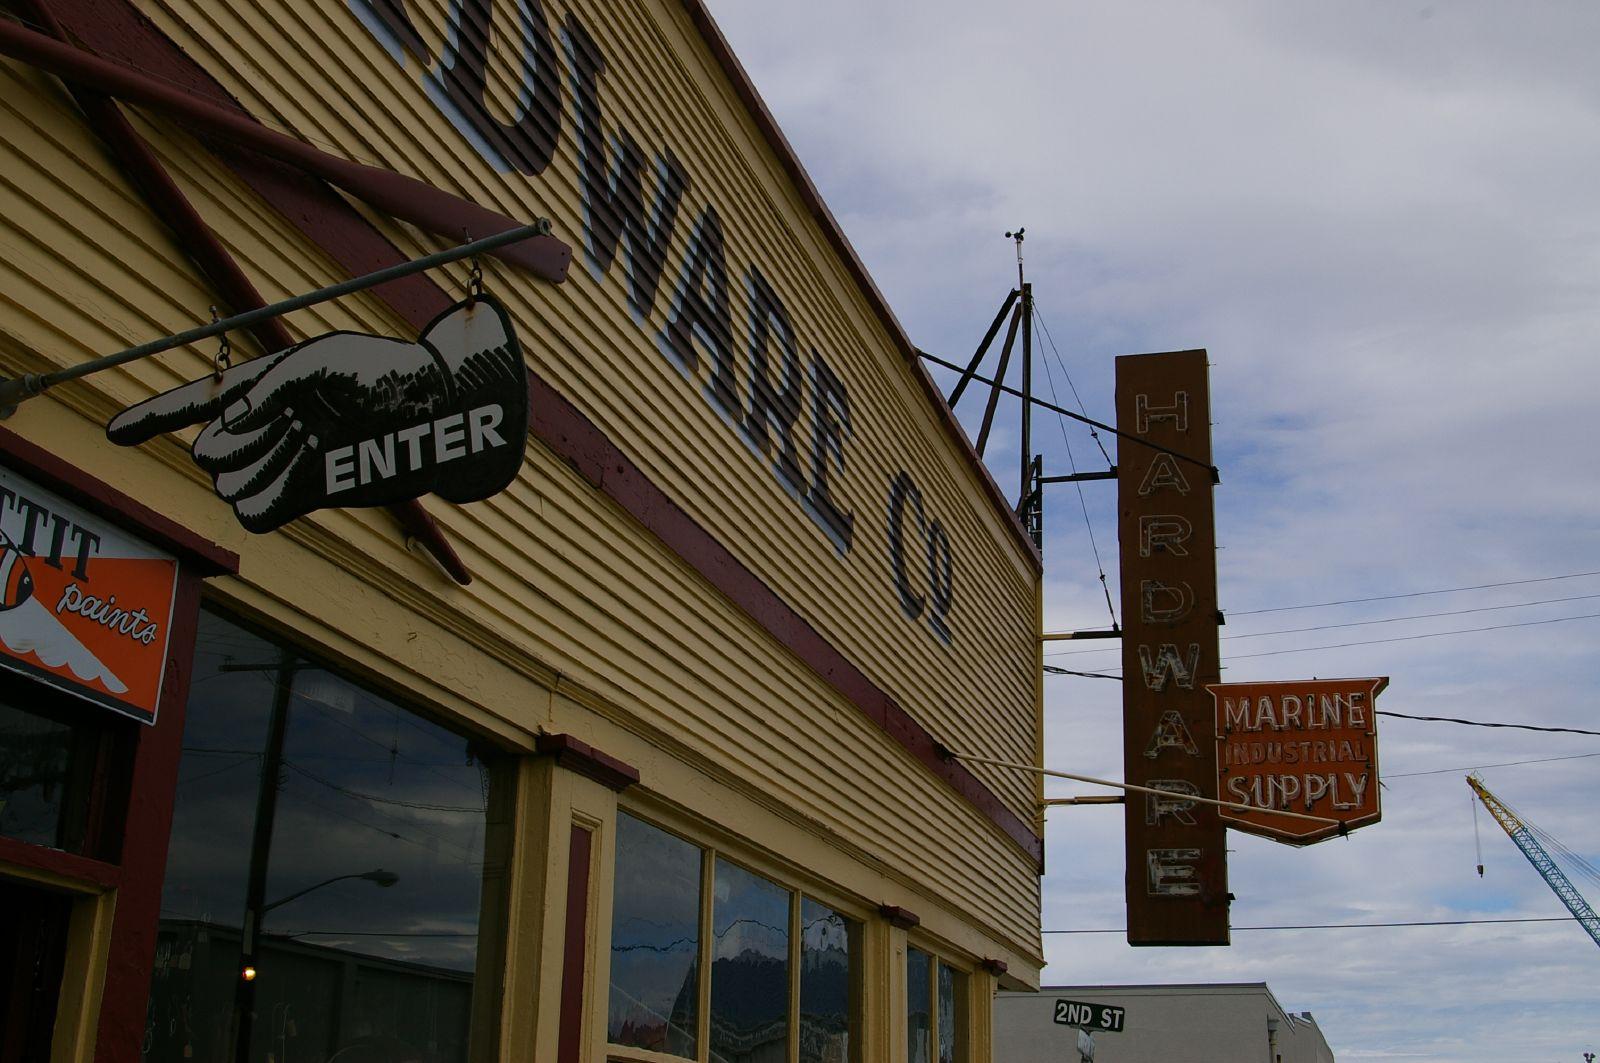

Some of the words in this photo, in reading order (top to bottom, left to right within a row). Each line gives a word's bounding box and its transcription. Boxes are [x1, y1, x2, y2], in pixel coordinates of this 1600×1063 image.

[324, 403, 507, 495] ENTER
[56, 583, 157, 646] paints
[1134, 390, 1201, 896] HARDWARE
[1224, 692, 1366, 732] MARINE
[1225, 739, 1369, 765] INDUSTRIAL
[1227, 772, 1369, 812] SUPPLY
[1056, 1003, 1092, 1025] 2ND
[1100, 1008, 1124, 1029] ST
